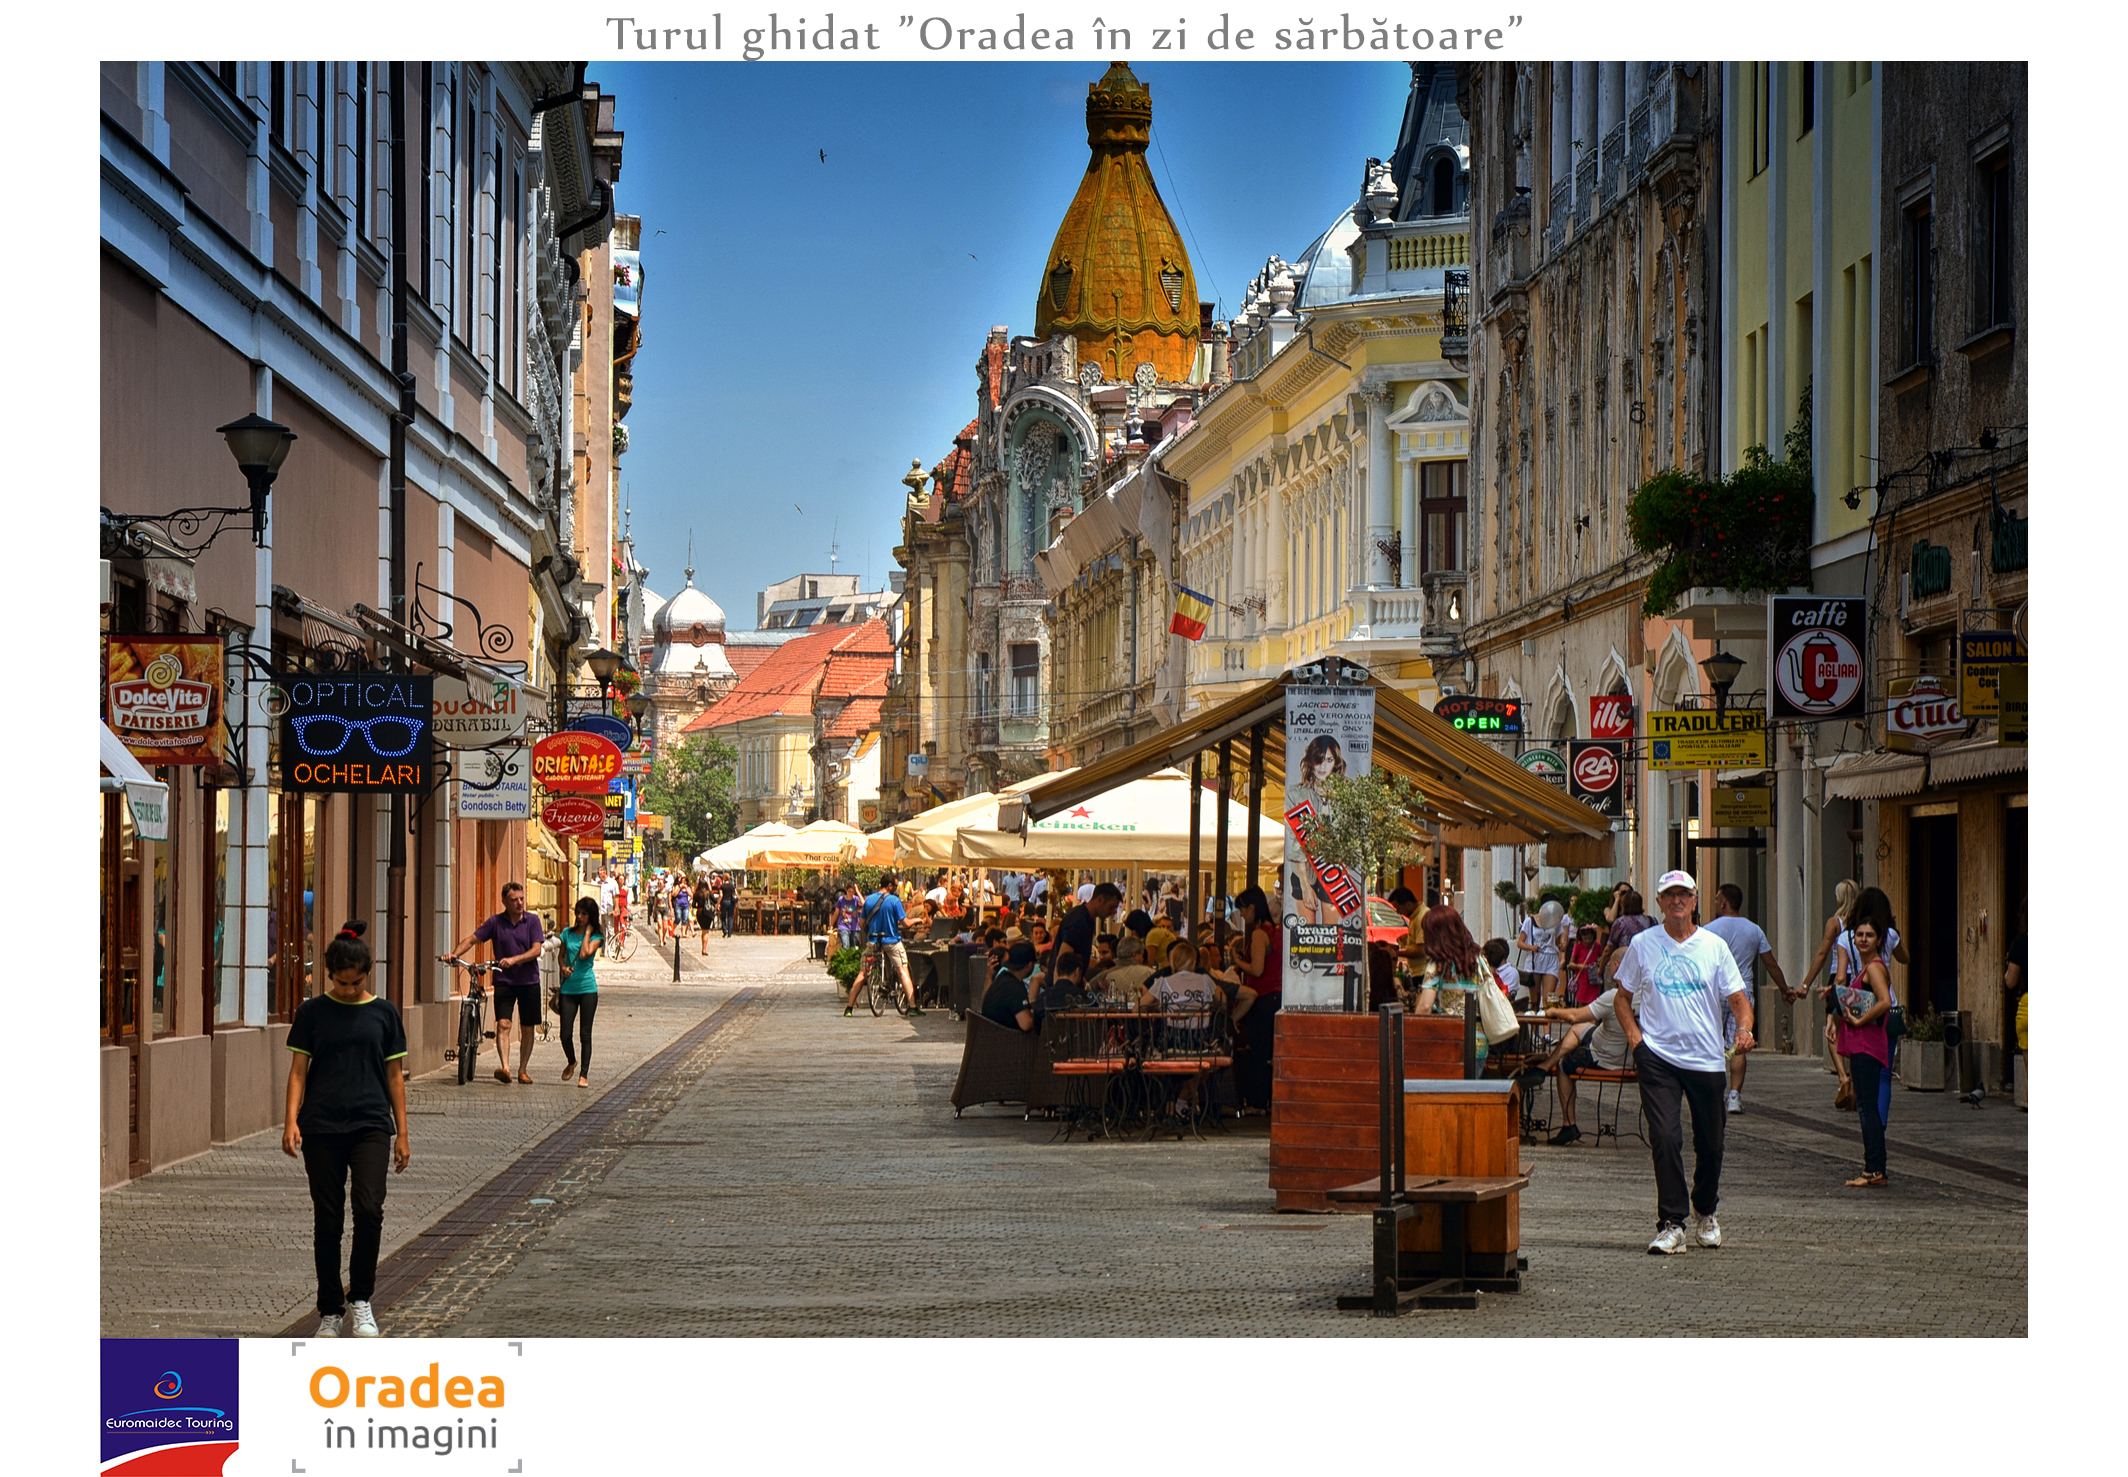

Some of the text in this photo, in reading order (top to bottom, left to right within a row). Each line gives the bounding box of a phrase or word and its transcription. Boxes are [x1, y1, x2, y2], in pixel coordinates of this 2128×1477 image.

[1791, 601, 1847, 626] caffè
[1966, 641, 2012, 658] SALON
[120, 688, 203, 713] DolceVita
[292, 682, 424, 708] OPTICAL
[1438, 701, 1517, 716] HOT SPOT
[121, 714, 200, 729] PATISERIE
[1289, 710, 1316, 725] Lee
[1454, 717, 1500, 729] OPEN
[1593, 701, 1631, 735] illy
[1652, 714, 1764, 731] TRADUCERI
[535, 755, 615, 774] ORIENTALE
[1579, 756, 1613, 775] RA
[294, 763, 421, 785] OCHELARI
[461, 800, 527, 813] Gondosch Betty
[545, 809, 601, 823] Frizerie
[1297, 926, 1338, 935] brand
